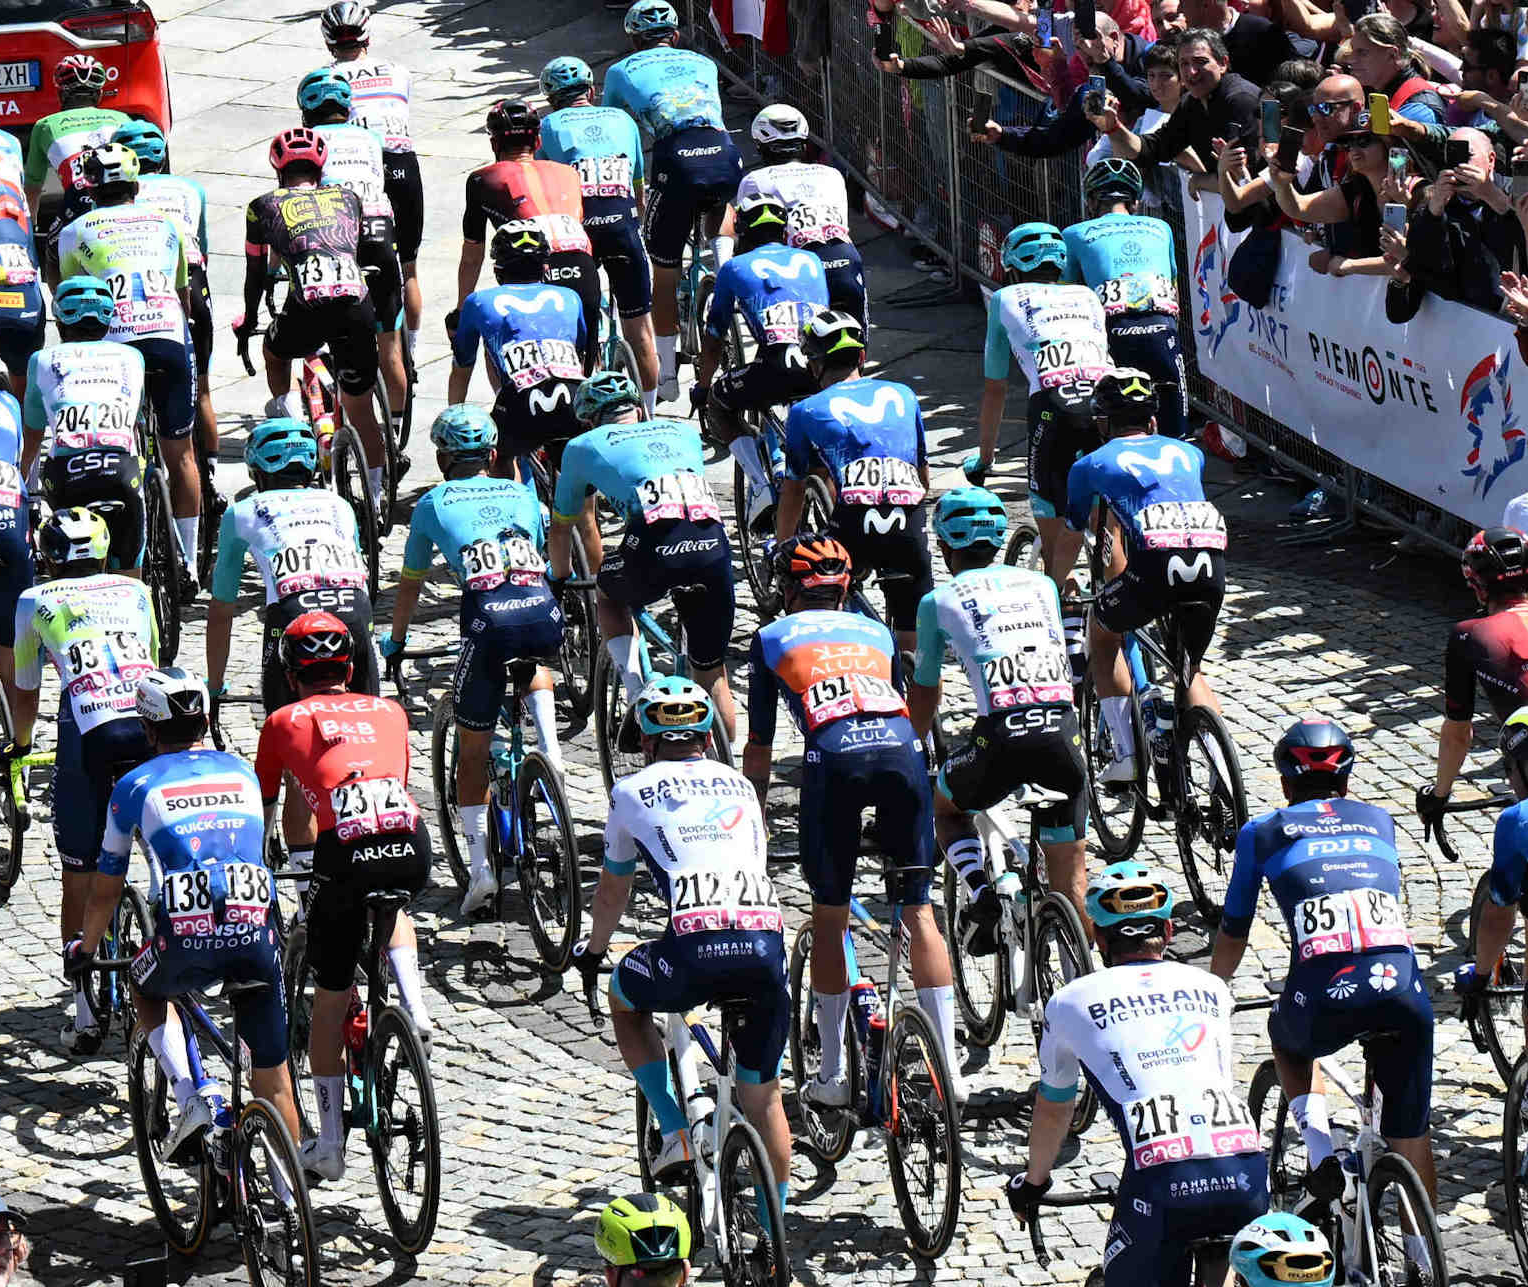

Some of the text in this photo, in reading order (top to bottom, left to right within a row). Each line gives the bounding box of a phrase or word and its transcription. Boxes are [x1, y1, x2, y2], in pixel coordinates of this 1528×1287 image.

[677, 145, 722, 158] Wilier
[793, 204, 817, 232] 35
[1099, 279, 1122, 305] 33
[118, 310, 164, 325] Circus
[765, 304, 798, 326] 121
[1111, 323, 1171, 337] Wilier
[504, 341, 539, 376] 127
[1036, 341, 1075, 373] 202
[1308, 331, 1439, 414] PIEMONTE
[56, 403, 92, 435] 204
[605, 423, 680, 442] ASTANA
[66, 451, 121, 474] CSF
[842, 458, 881, 489] 126
[443, 482, 517, 496] ASTANA
[642, 474, 676, 507] 34
[273, 543, 312, 576] 207
[464, 541, 498, 573] 36
[655, 538, 720, 558] Wilier
[298, 589, 355, 609] CSF
[484, 597, 545, 613] Wilier
[68, 639, 100, 675] 93
[985, 655, 1028, 689] 208
[810, 677, 851, 709] 151
[290, 697, 394, 721] ARKEA
[1004, 708, 1063, 732] CSF
[321, 719, 377, 736] B&B
[840, 729, 899, 744] ALULA
[638, 776, 752, 801] BAHRAIN
[165, 792, 245, 812] SOUDAL
[337, 785, 371, 819] 23
[174, 817, 247, 835] QUICK-STEP
[678, 824, 718, 835] Bapco
[682, 829, 734, 843] energies
[1282, 822, 1379, 836] Groupama
[351, 841, 416, 864] ARKEA
[1307, 840, 1351, 857] FDJ
[166, 873, 212, 913] 138
[674, 873, 720, 912] 212
[1302, 895, 1336, 935] 85
[181, 931, 261, 950] OUTDOOR
[697, 941, 754, 954] BAHRAIN
[1087, 988, 1220, 1021] BAHRAIN
[1094, 1001, 1221, 1031] VICTORIOUS
[1136, 1046, 1181, 1062] Bapco
[1141, 1053, 1198, 1071] energies
[1131, 1094, 1180, 1144] 217
[1170, 1175, 1237, 1193] BAHRAIN
